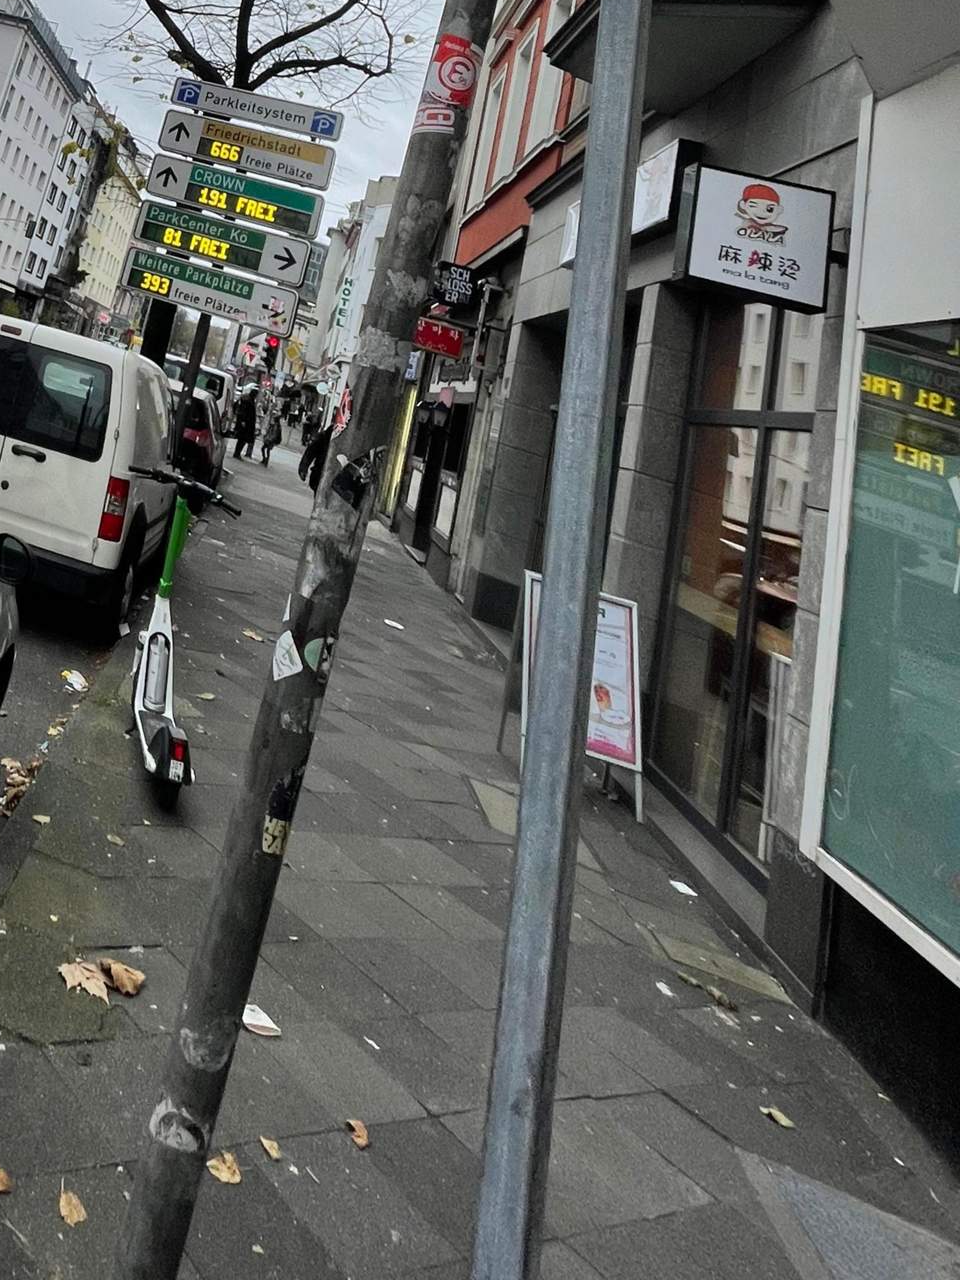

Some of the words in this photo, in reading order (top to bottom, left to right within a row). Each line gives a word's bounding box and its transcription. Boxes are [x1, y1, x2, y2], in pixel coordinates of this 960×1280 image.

[205, 91, 306, 125] Parkleitsystem
[206, 125, 302, 156] Friedrichstadt
[210, 141, 241, 162] 666
[245, 154, 272, 171] freie
[277, 162, 313, 181] Plätze
[194, 169, 246, 193] CROWN
[198, 188, 228, 210] 191
[235, 197, 278, 222] FREI
[149, 207, 225, 236] ParkCenter
[230, 227, 248, 243] Kö
[737, 226, 784, 244] OLALA
[162, 227, 182, 247] 81
[190, 235, 230, 260] FREI
[138, 253, 180, 276] Weitere
[185, 266, 250, 296] Parkplätze
[450, 266, 470, 282] SCH
[722, 268, 742, 277] ma
[744, 270, 756, 280] la
[759, 276, 790, 290] tang
[140, 272, 170, 295] 393
[173, 287, 200, 305] freie
[204, 296, 241, 316] Plätze
[336, 277, 353, 328] HOTEL
[445, 290, 459, 304] ER
